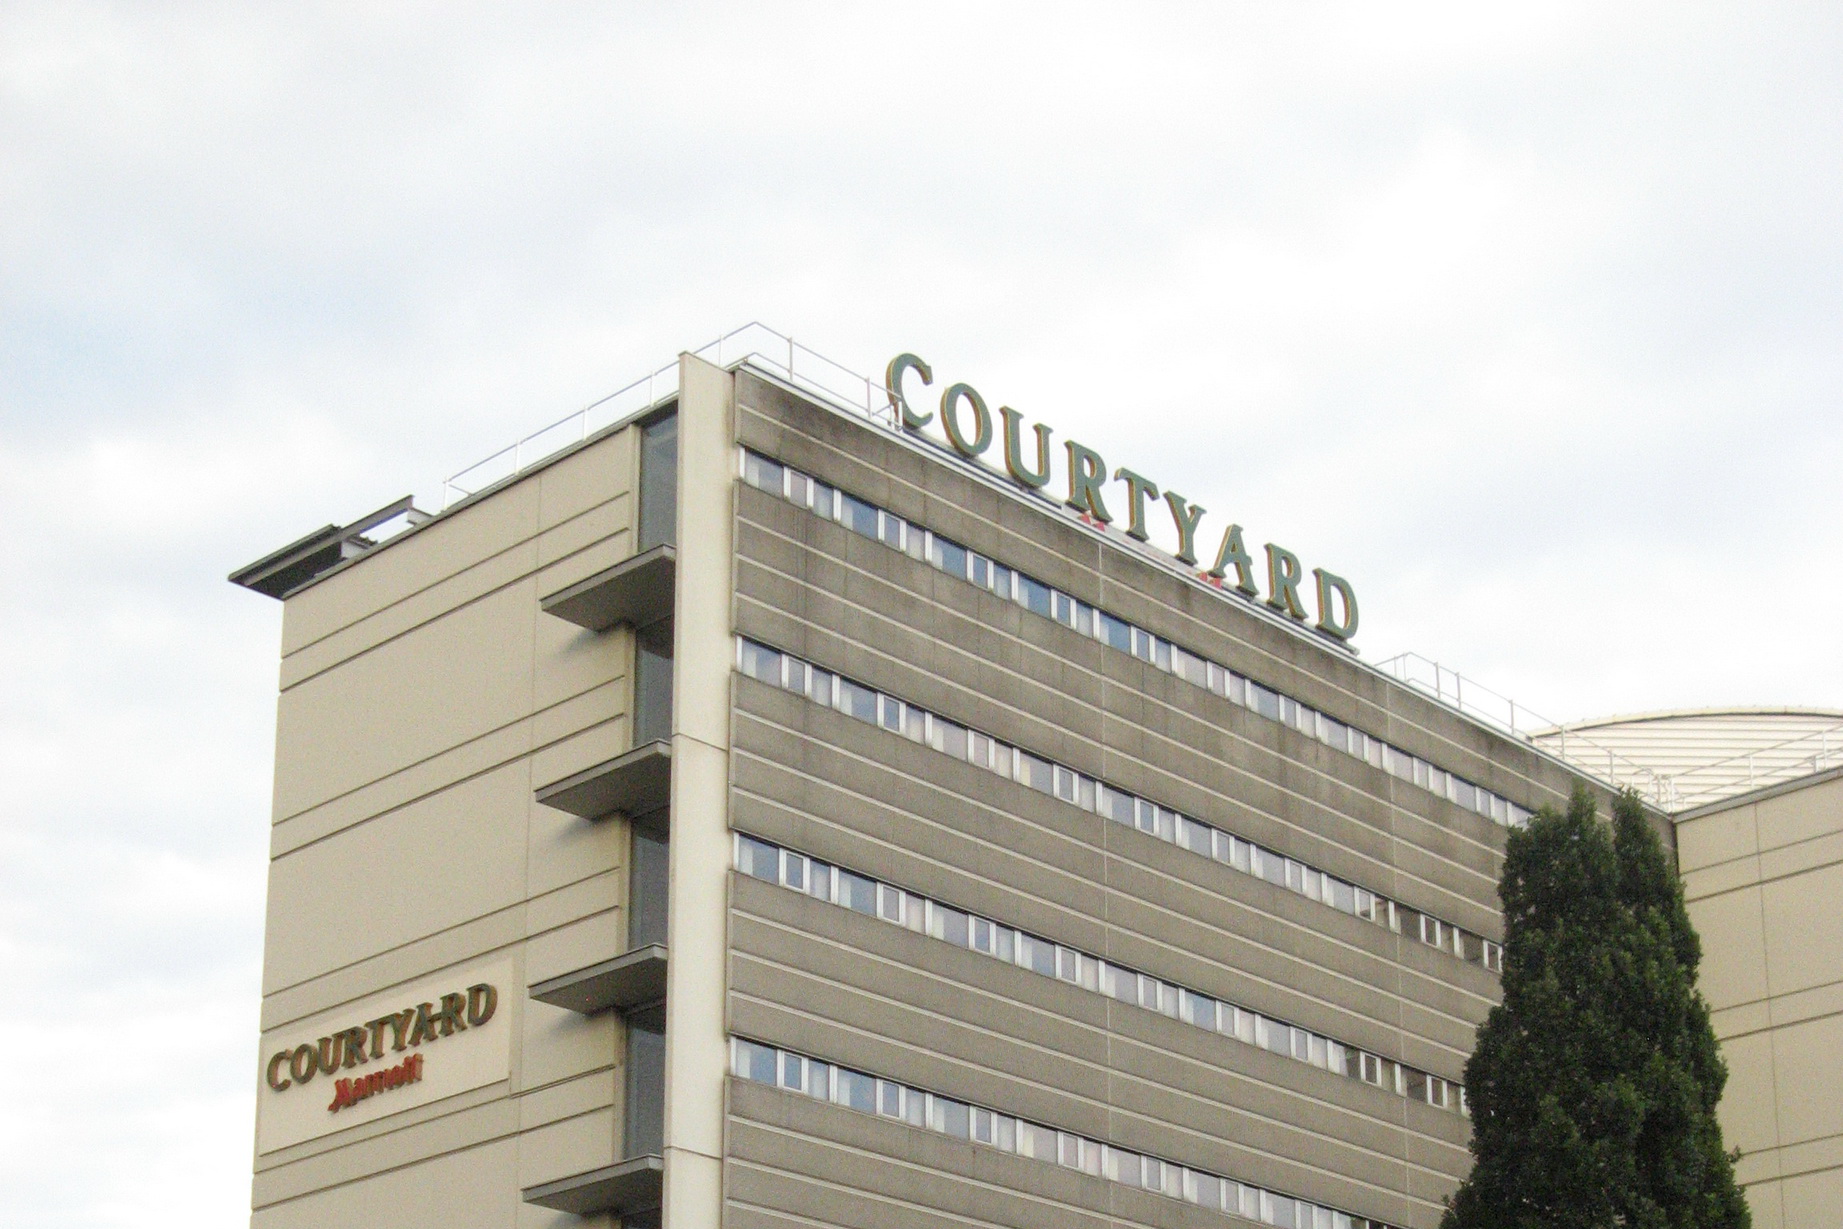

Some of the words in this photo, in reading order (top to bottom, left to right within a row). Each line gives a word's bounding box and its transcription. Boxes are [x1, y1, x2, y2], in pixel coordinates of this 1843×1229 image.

[886, 352, 1359, 640] COURTYARD
[266, 982, 498, 1092] COURTYARD
[327, 1052, 424, 1113] Marriott
